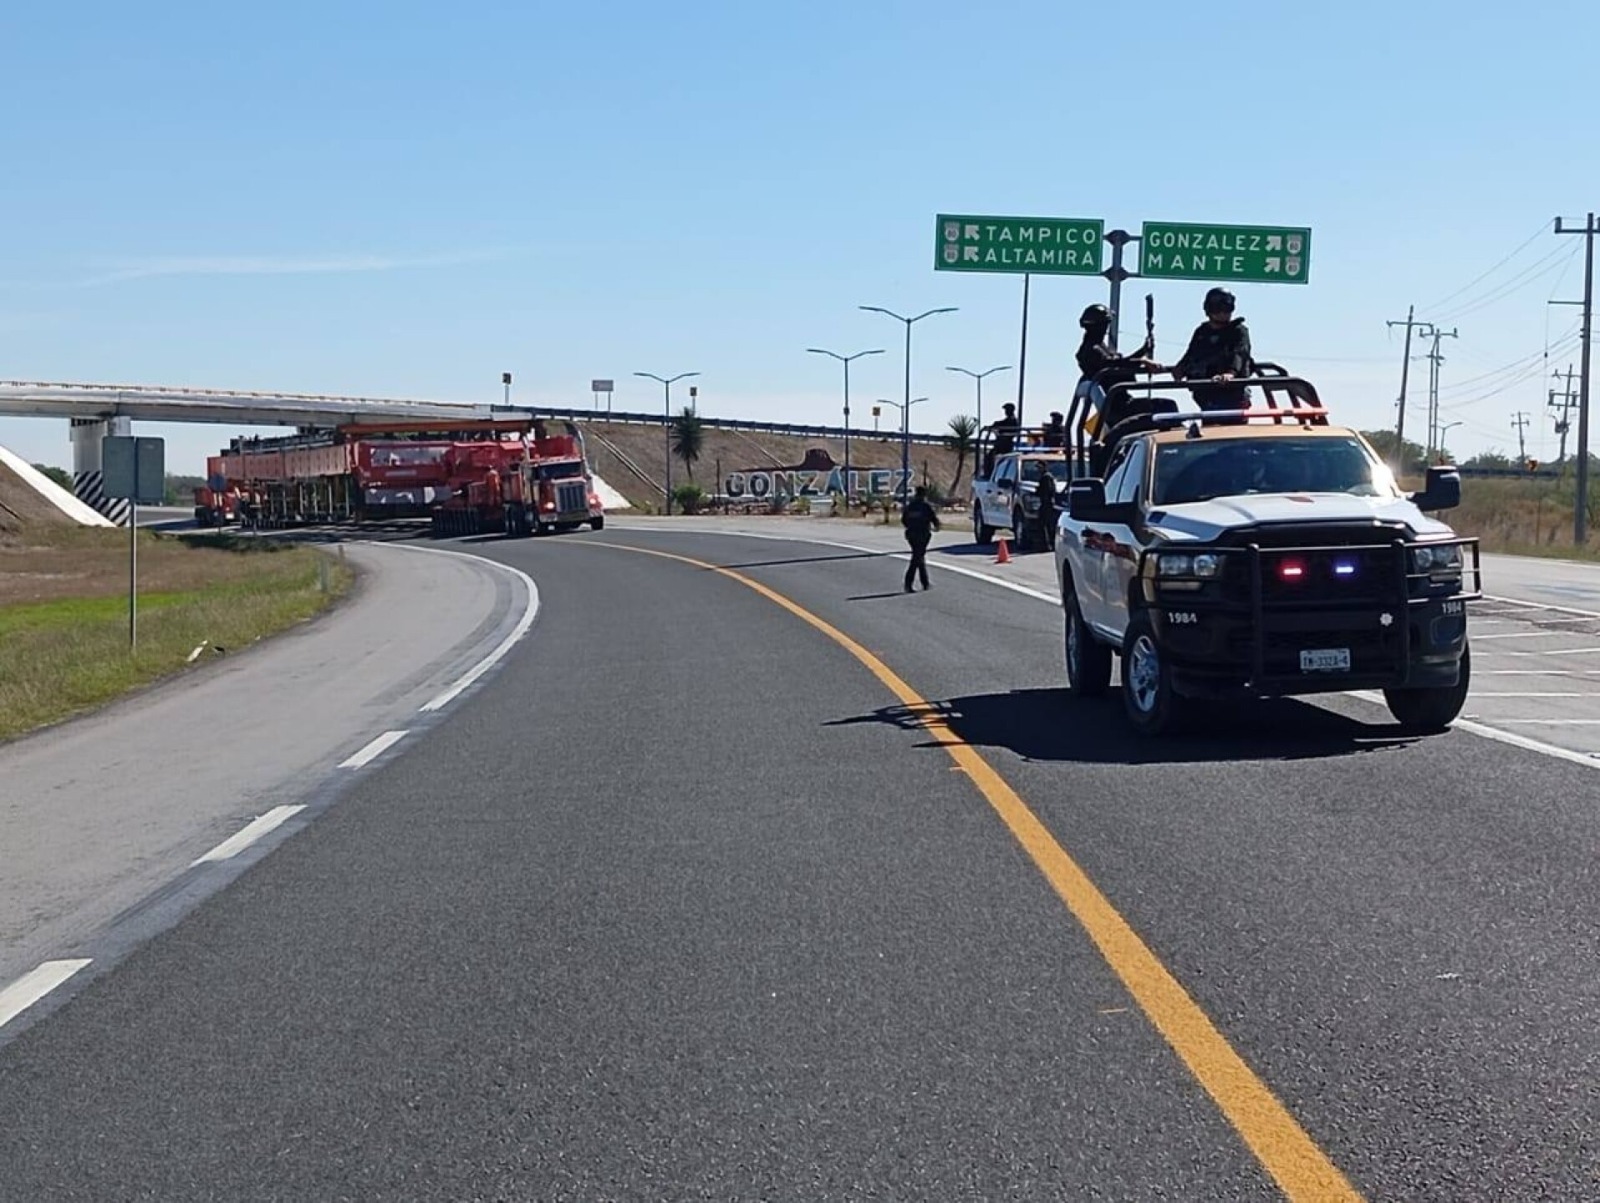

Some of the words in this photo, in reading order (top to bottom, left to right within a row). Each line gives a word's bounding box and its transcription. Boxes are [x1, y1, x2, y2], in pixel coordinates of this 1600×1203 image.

[985, 225, 1097, 245] TAMPICO
[1149, 231, 1262, 251] GONZALEZ
[984, 247, 1095, 266] ALTAMIRA
[1147, 253, 1245, 273] MANTE
[1168, 611, 1198, 624] 1984
